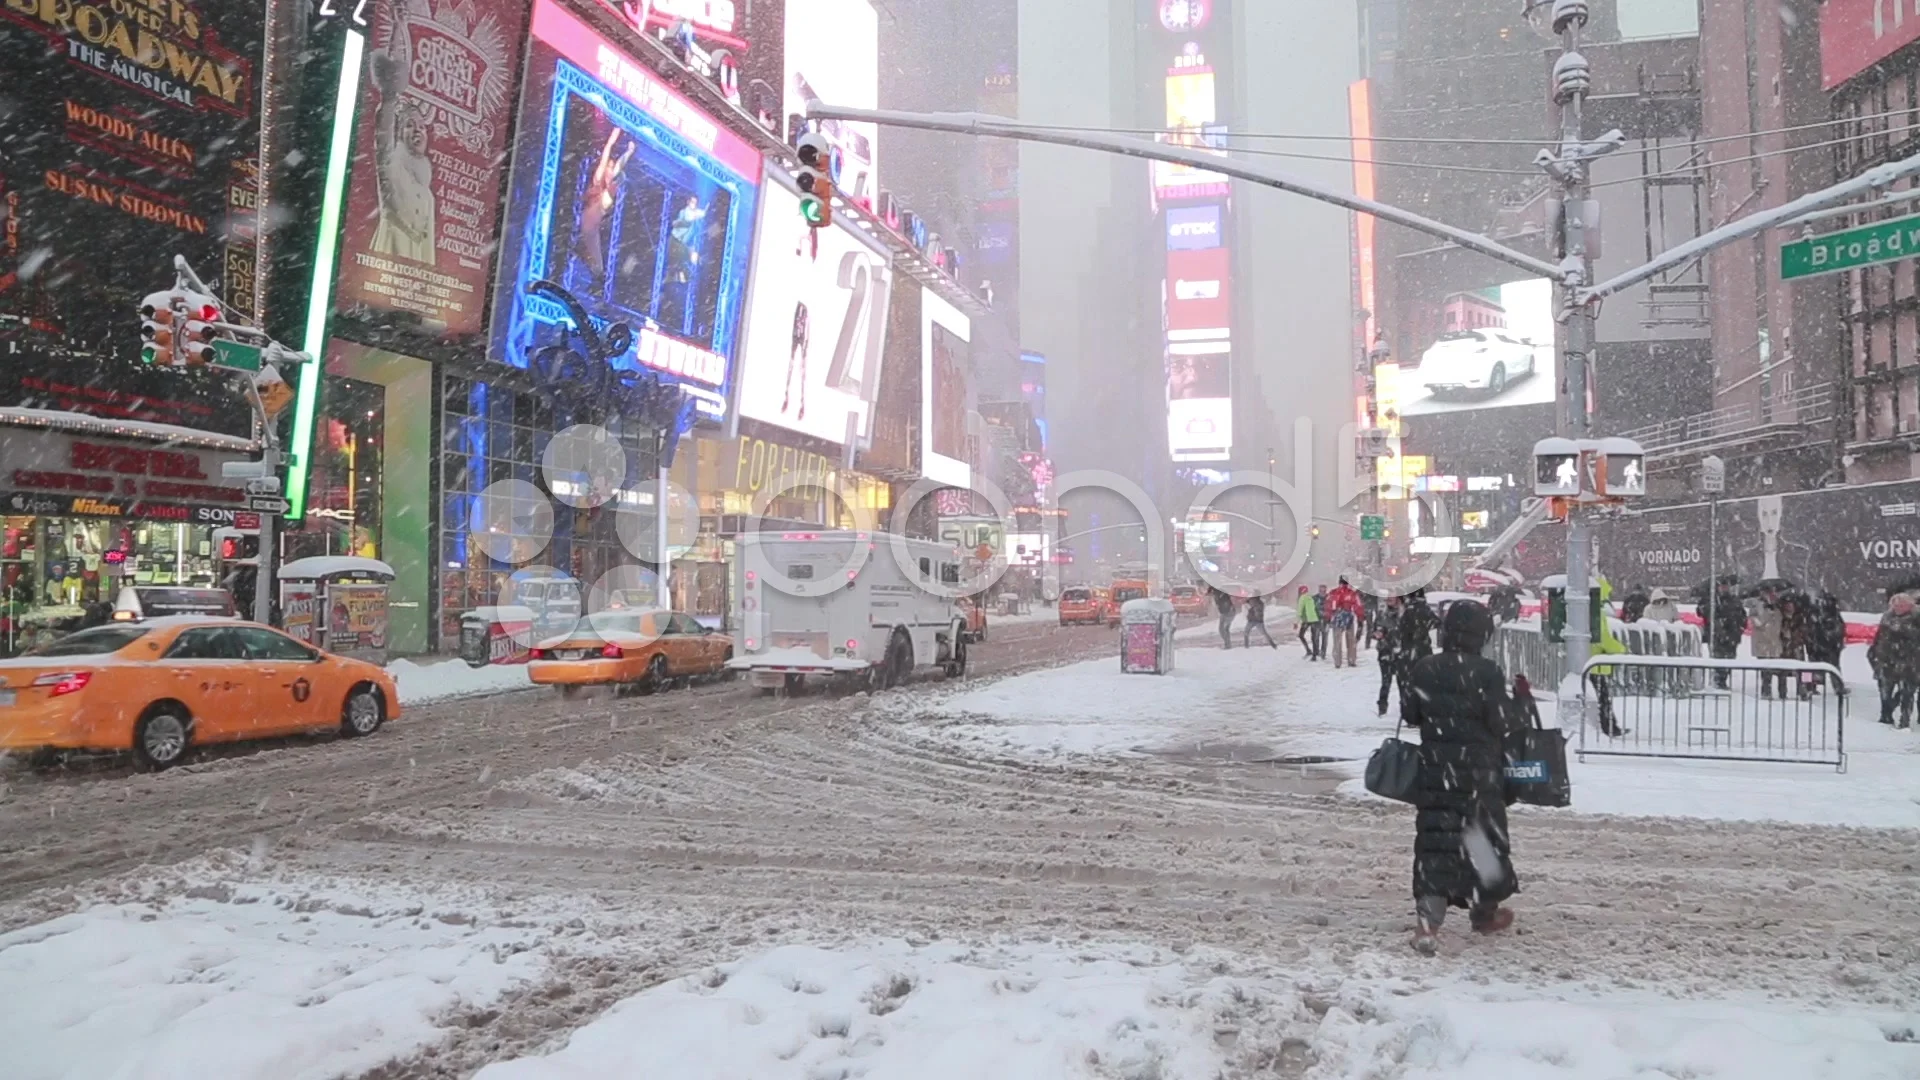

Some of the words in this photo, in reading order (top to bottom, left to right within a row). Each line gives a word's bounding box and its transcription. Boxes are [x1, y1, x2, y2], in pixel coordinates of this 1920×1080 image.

[417, 38, 477, 86] GREAT
[67, 38, 106, 71] THE
[110, 58, 194, 106] MUSICAL
[411, 59, 477, 107] COMET
[65, 101, 138, 141] WOODY
[142, 130, 196, 162] ALLEN
[437, 167, 460, 186] THE
[1158, 183, 1228, 199] TOSHIBA
[46, 170, 115, 206] SUSAN
[120, 194, 206, 234] STROMAN
[735, 435, 827, 501] FOREVER
[71, 497, 123, 516] Nikon
[134, 502, 190, 520] Canon
[199, 507, 238, 521] SON
[1638, 548, 1700, 565] VORNADO
[1504, 762, 1542, 778] mavi
